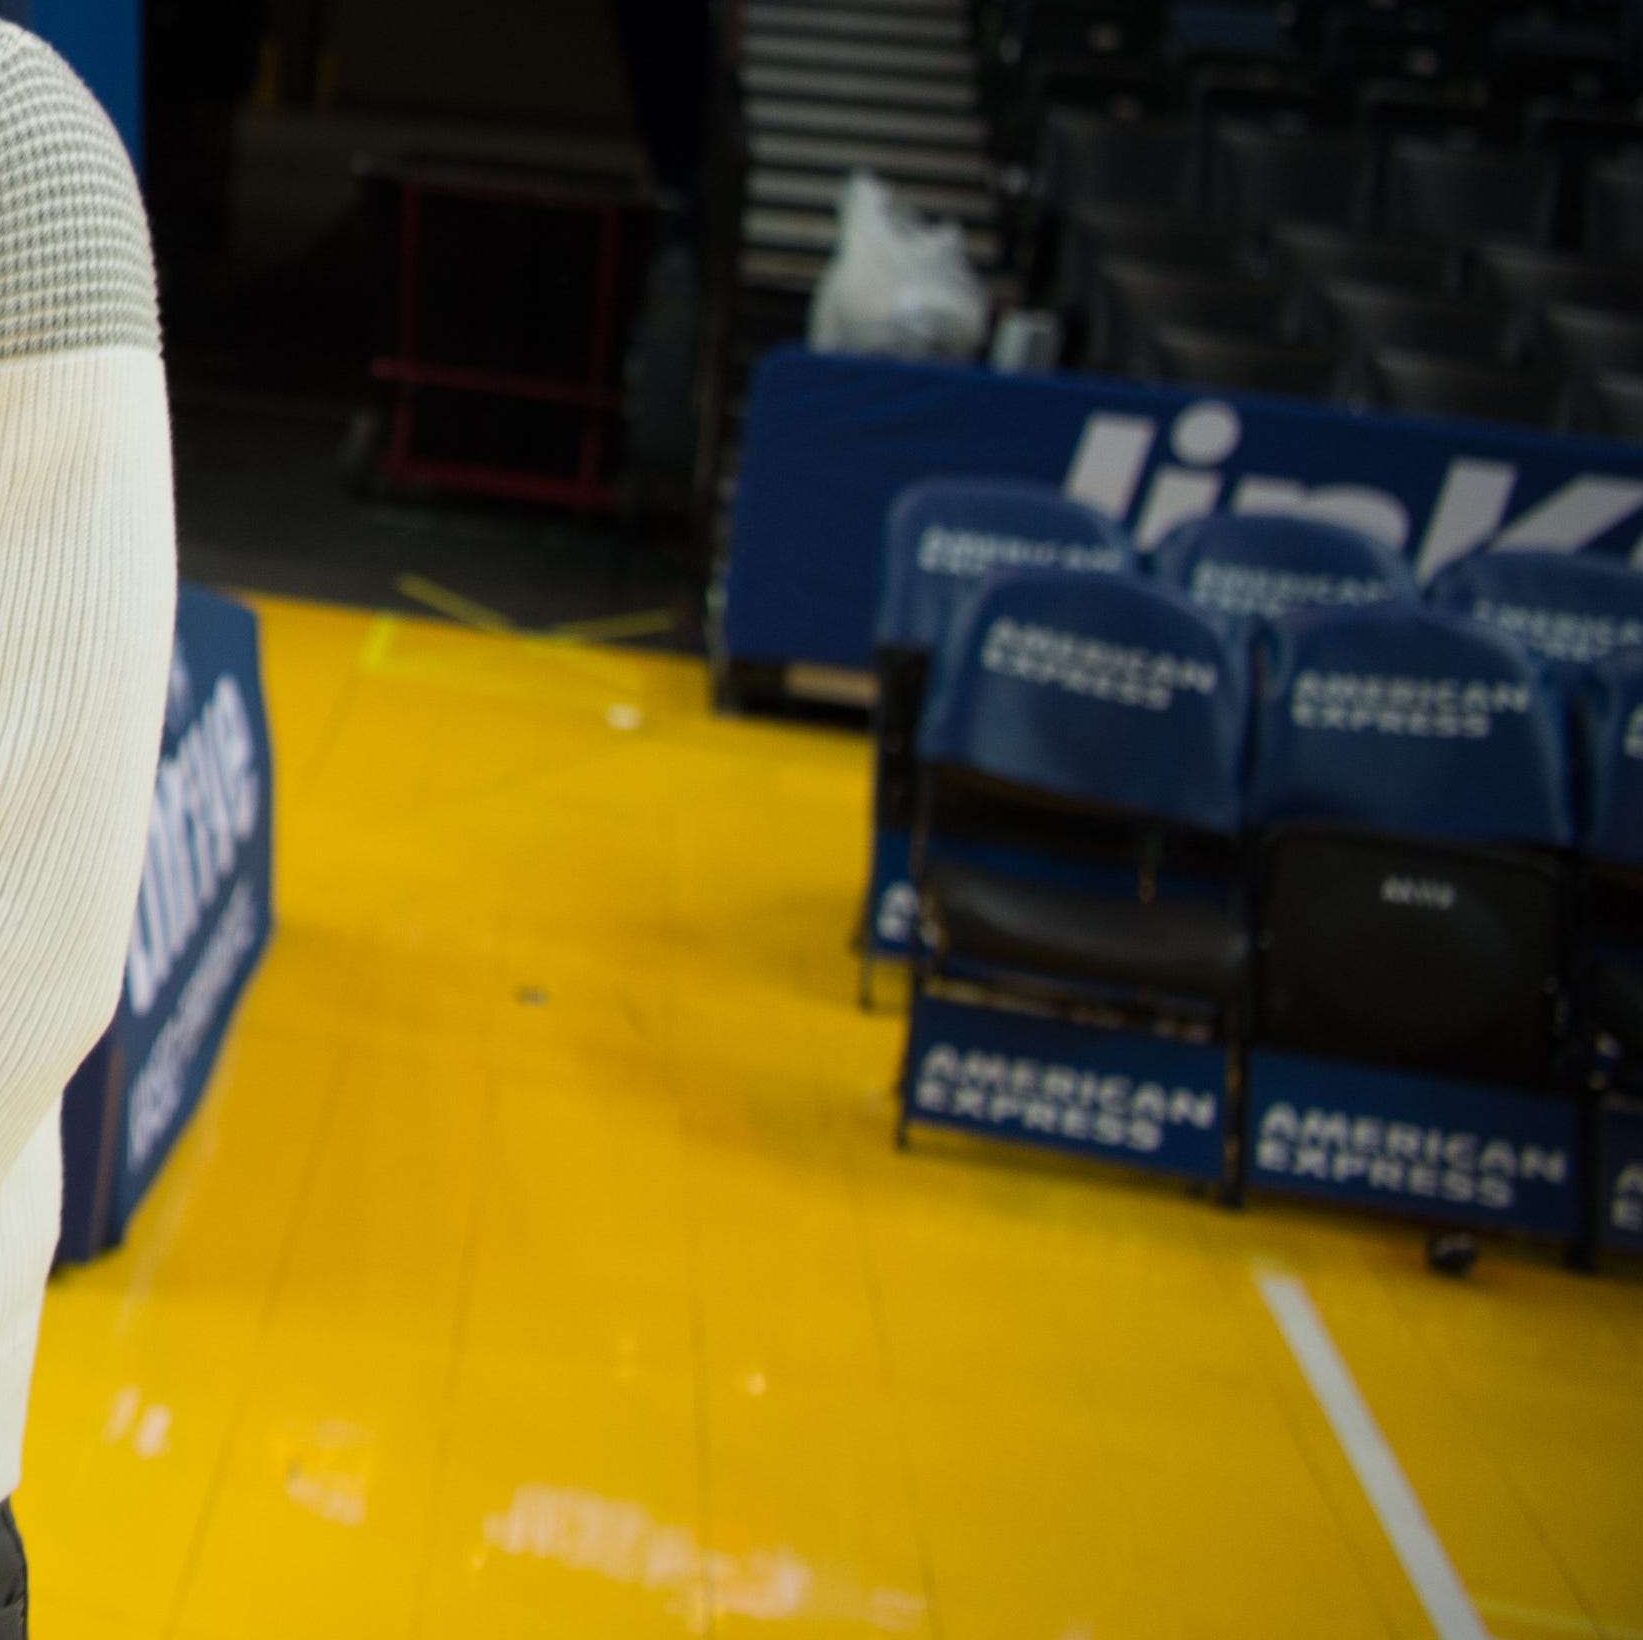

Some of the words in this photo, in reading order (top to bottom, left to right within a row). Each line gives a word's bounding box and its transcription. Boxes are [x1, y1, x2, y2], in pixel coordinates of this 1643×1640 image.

[982, 647, 1172, 711] EXPRESS
[990, 619, 1217, 695] AMERICAN
[1295, 671, 1532, 713] AMERICAN
[1290, 701, 1492, 739] EXPRESS
[916, 1077, 1164, 1153] EXPRESS
[921, 1043, 1217, 1130] AMERICAN
[1255, 1135, 1514, 1210] EXPRESS
[1259, 1102, 1569, 1184] AMERICAN
